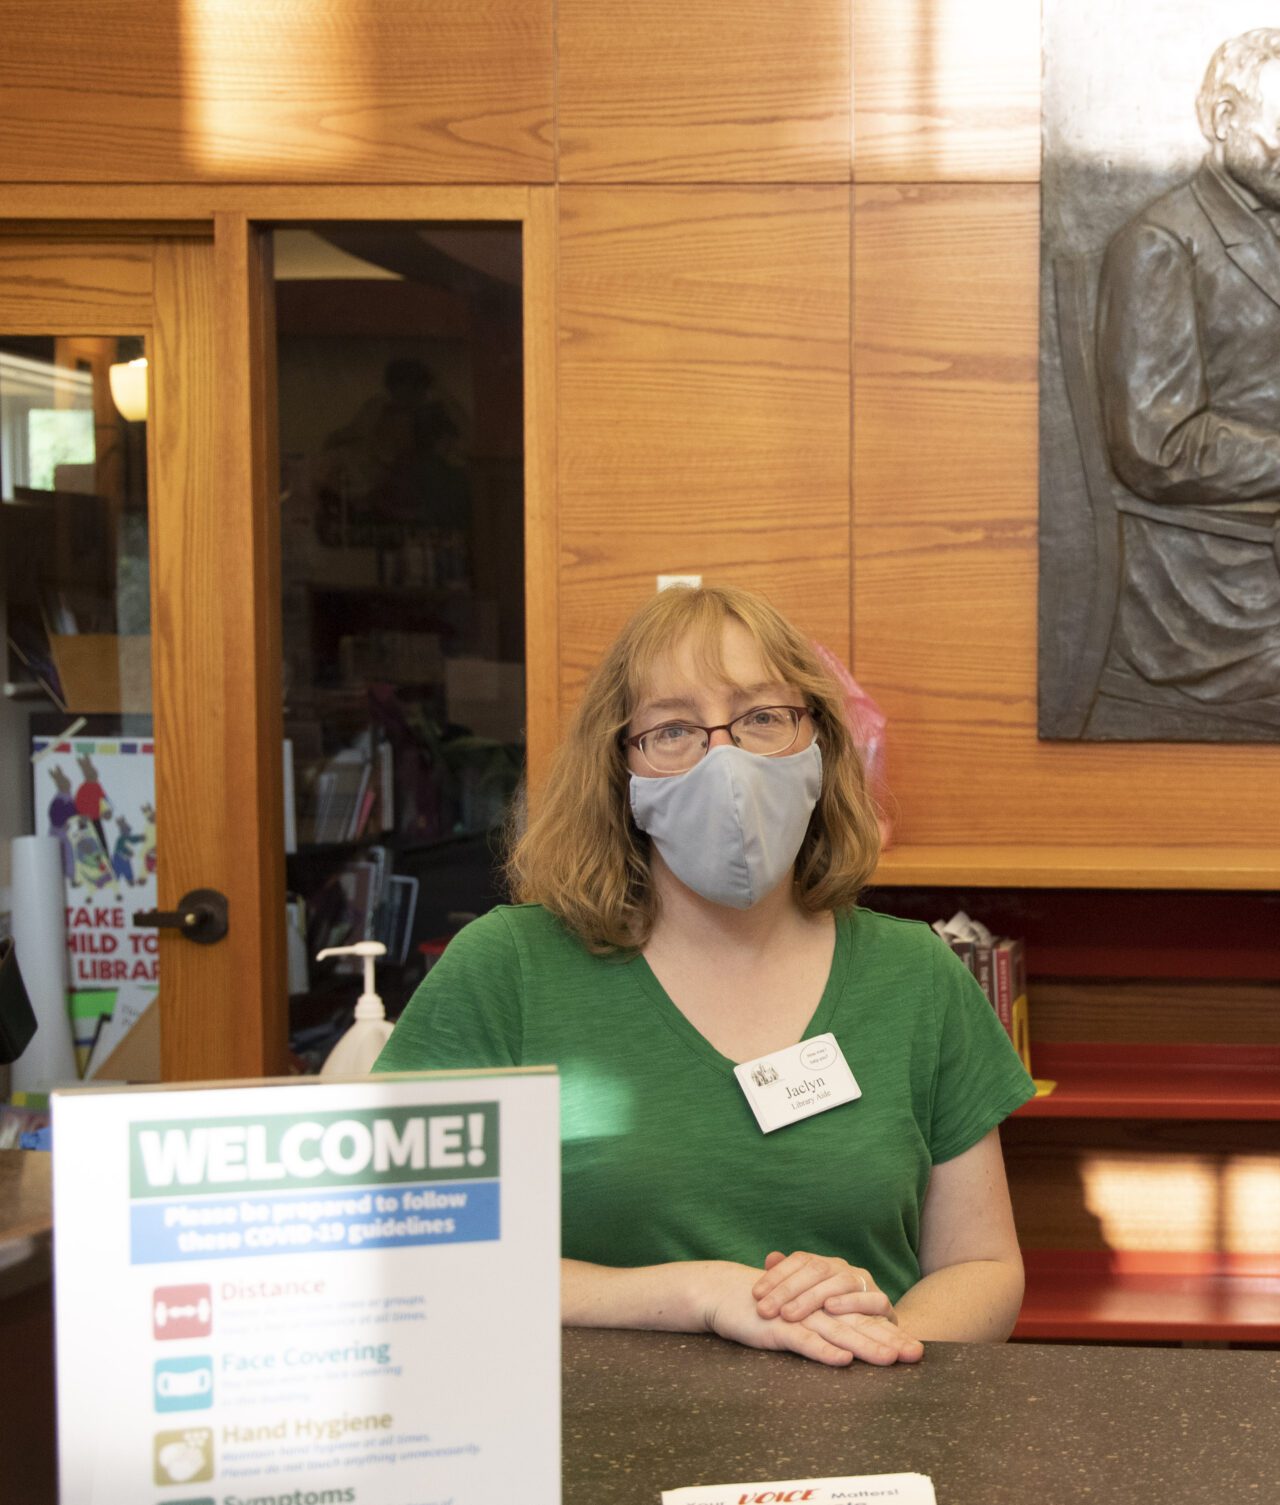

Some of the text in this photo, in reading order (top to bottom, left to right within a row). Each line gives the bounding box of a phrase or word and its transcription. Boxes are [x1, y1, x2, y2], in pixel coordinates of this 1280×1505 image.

[65, 907, 124, 928] TAKE
[66, 933, 160, 955] HILD TO
[785, 1077, 825, 1099] Jaclyn
[138, 1113, 487, 1187] WELCOME!
[163, 1191, 467, 1229] Please be prepared to follow
[244, 1222, 345, 1248] COVID-19
[348, 1216, 456, 1244] guidelines
[221, 1278, 326, 1301] Distance
[221, 1339, 392, 1371] Face Covering
[222, 1411, 394, 1444] Hand Hygiene
[222, 1485, 356, 1505] Symptoms
[738, 1488, 822, 1505] VOICE
[831, 1489, 899, 1499] Matters!
